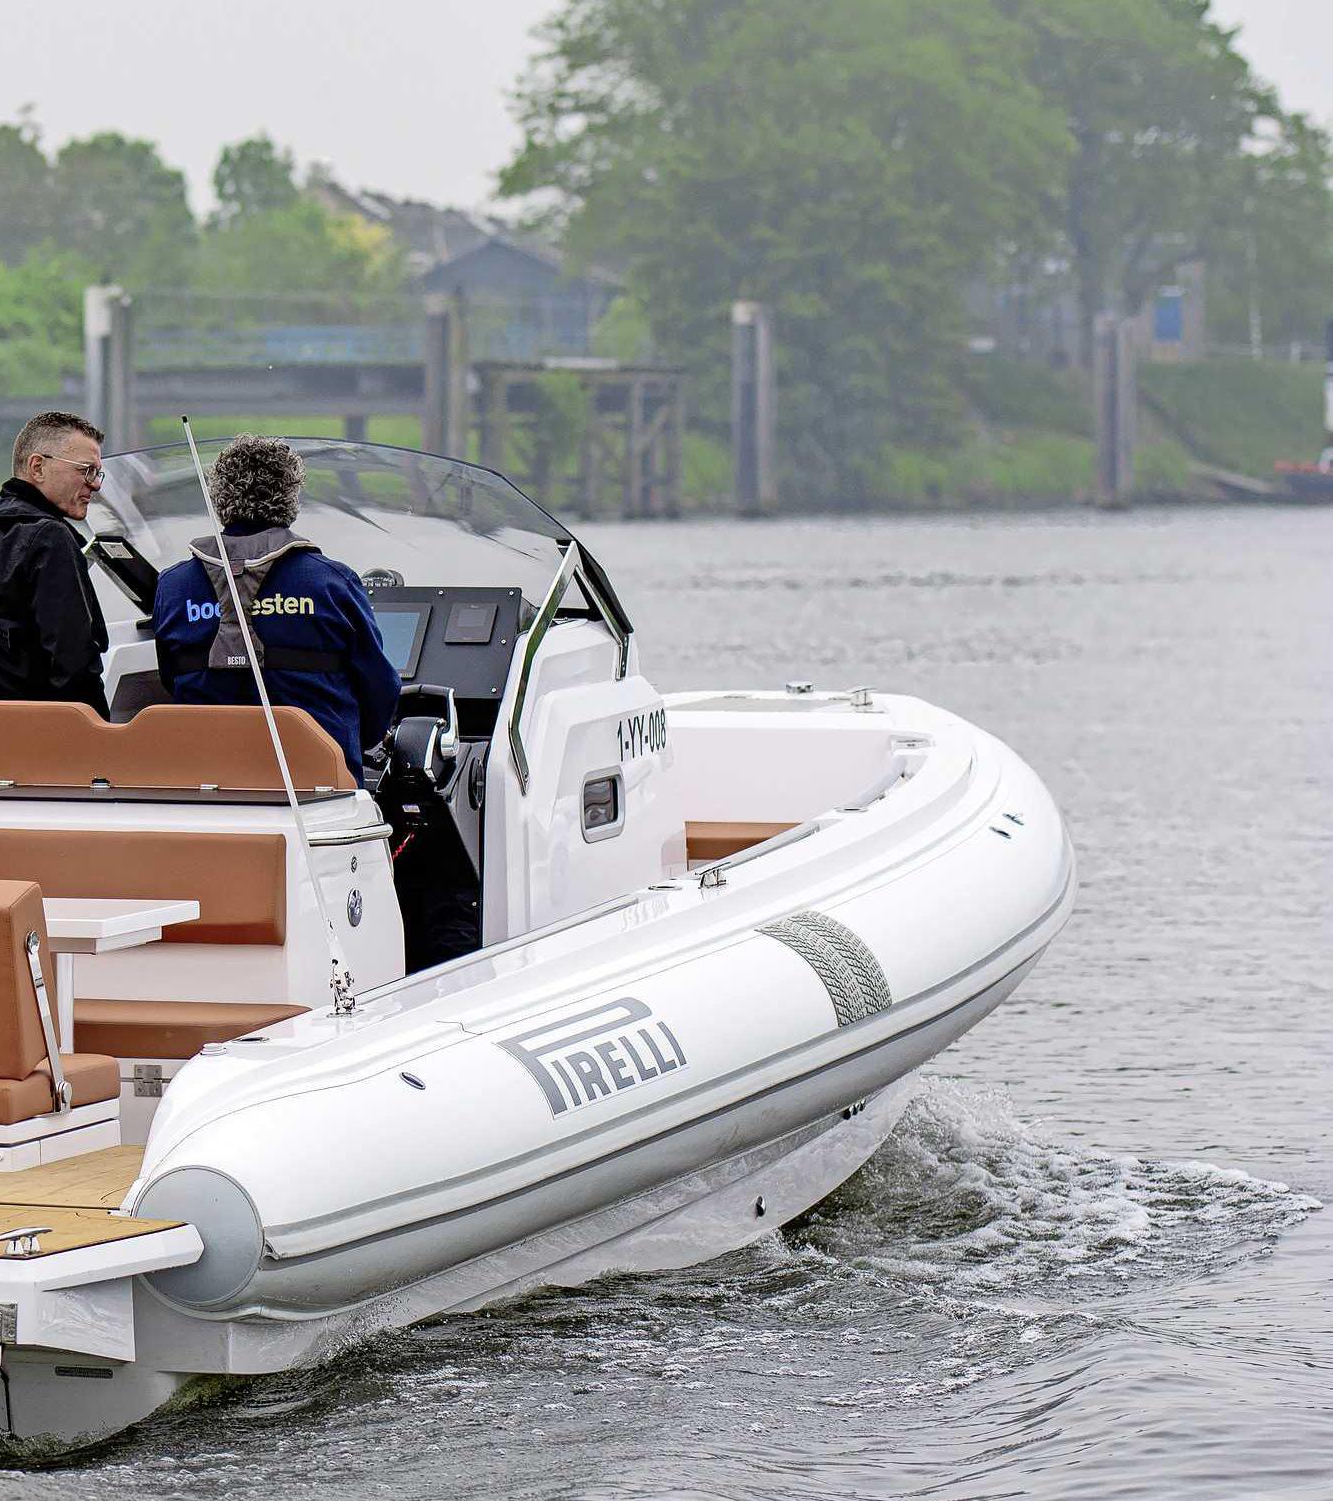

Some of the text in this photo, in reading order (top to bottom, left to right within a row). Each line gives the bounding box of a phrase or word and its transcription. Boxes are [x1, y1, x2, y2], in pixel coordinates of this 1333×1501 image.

[227, 656, 247, 666] BESTO
[617, 707, 666, 762] 1-YY-008
[497, 996, 688, 1115] PIRELLI
